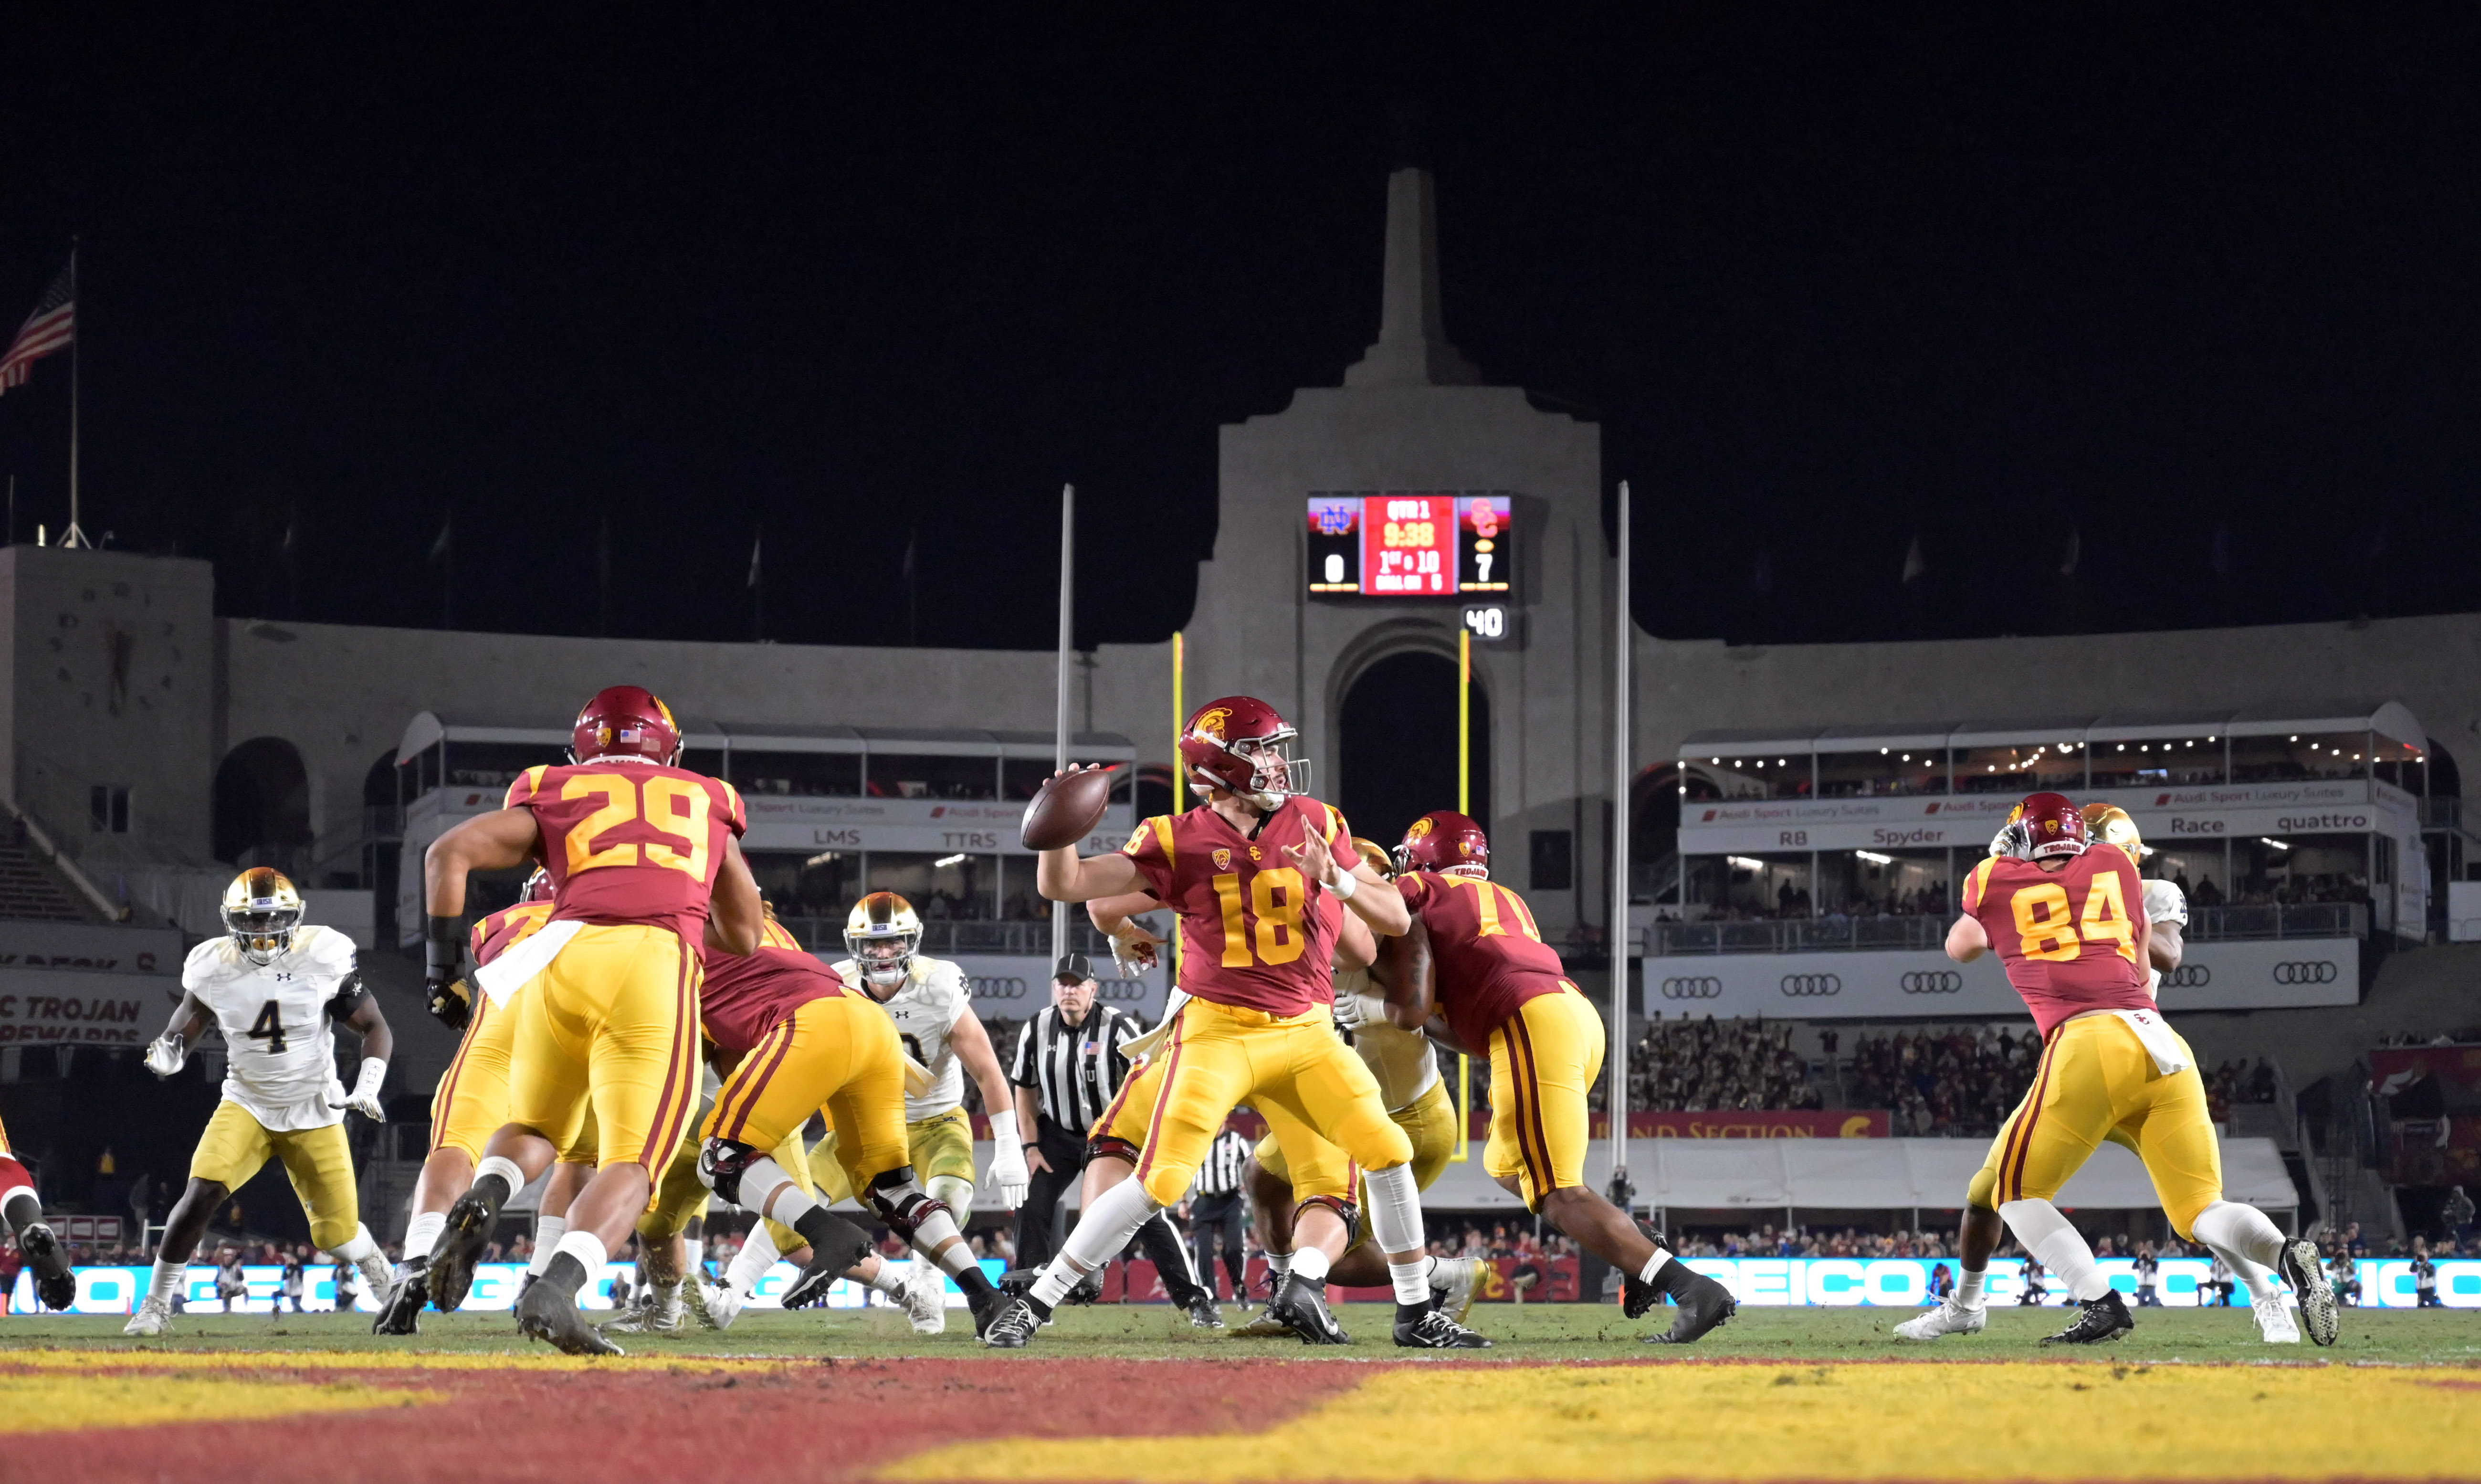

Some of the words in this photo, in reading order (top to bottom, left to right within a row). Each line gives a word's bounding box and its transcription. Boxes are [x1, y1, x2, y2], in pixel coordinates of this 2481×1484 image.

[1388, 501, 1418, 521] QTR
[1420, 501, 1430, 519] 1
[1384, 522, 1434, 547] 9:38
[1325, 554, 1344, 583] 0
[1417, 550, 1439, 573] 10
[1475, 553, 1493, 581] 7
[1466, 609, 1502, 637] 40
[2174, 792, 2206, 803] Audi
[2210, 791, 2250, 805] Sport
[2254, 788, 2299, 801] Luxury
[2304, 787, 2344, 799] Suites
[1944, 801, 1974, 812] Audi
[561, 774, 710, 883] 29
[2171, 817, 2225, 833] Race
[2278, 813, 2366, 832] quattro
[814, 829, 861, 845] LMS
[943, 832, 997, 848] TTRS
[1780, 831, 1807, 846] R8
[1873, 828, 1944, 846] Spyder
[1250, 846, 1261, 861] SC
[2043, 843, 2081, 853] TROJANS
[1219, 858, 1227, 866] 12
[1212, 867, 1305, 968] 18
[2010, 871, 2137, 964] 84
[27, 995, 141, 1022] TROJAN
[246, 999, 288, 1055] 4
[1086, 1070, 1095, 1082] U
